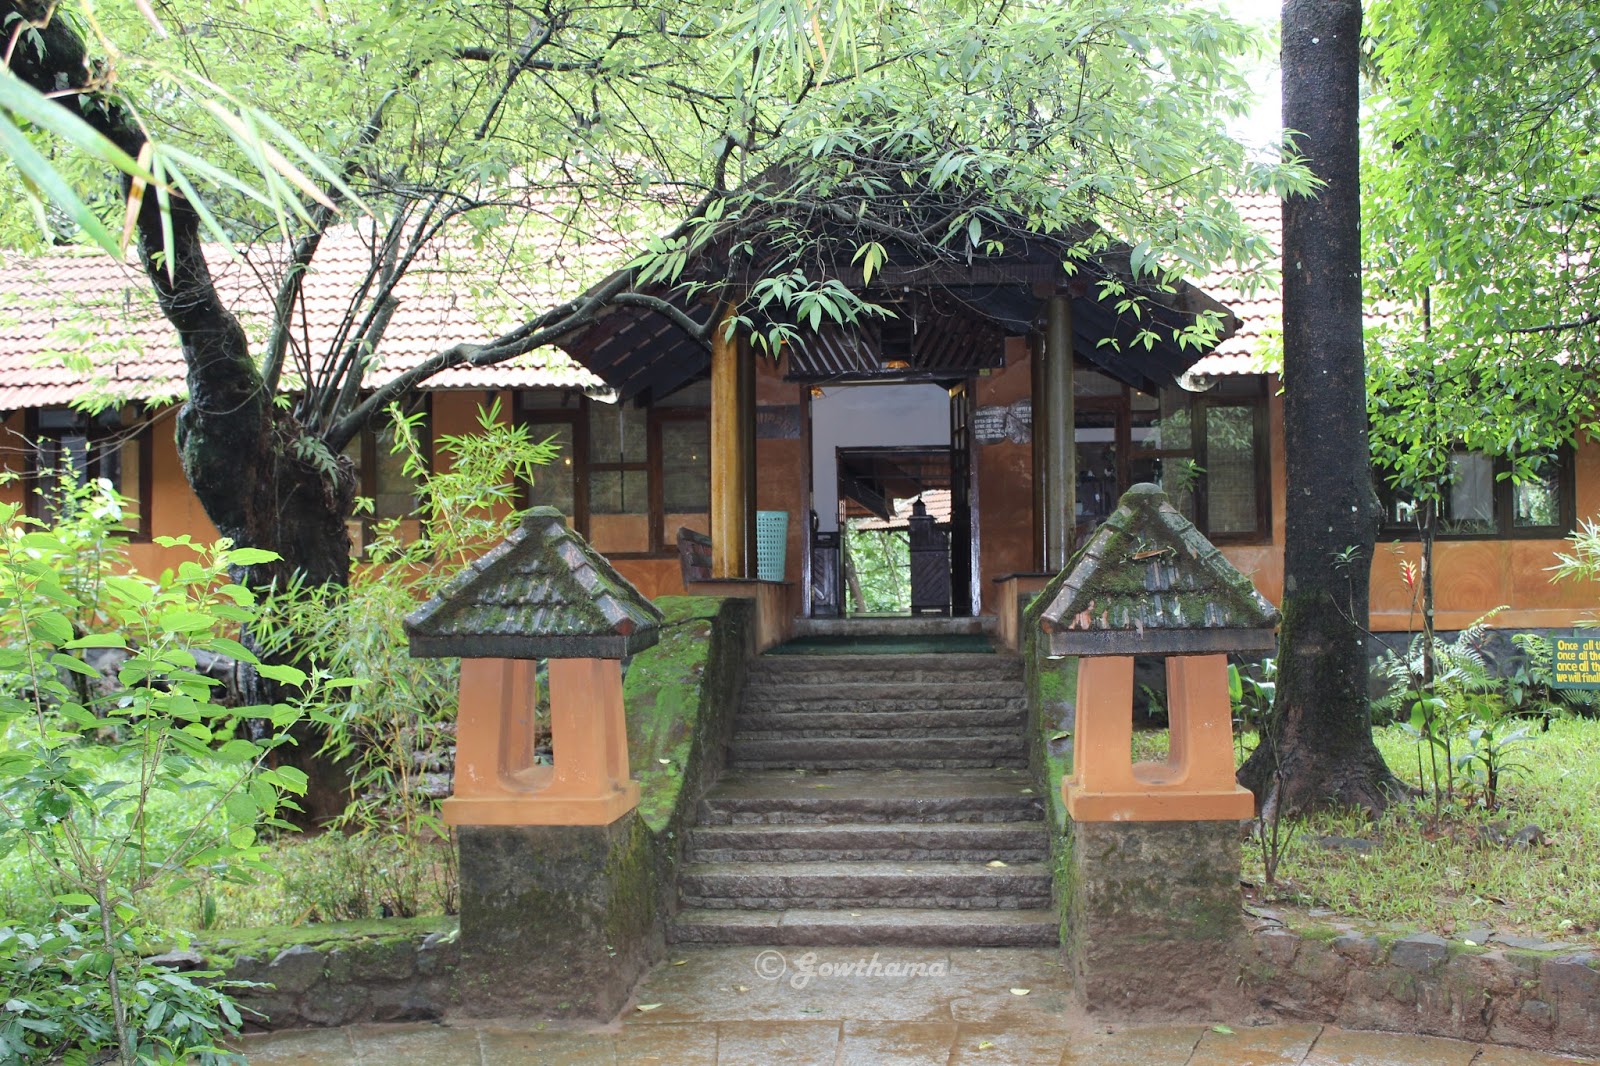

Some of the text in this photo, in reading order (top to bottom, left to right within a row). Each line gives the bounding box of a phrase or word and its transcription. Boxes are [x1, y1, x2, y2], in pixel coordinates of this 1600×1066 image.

[1557, 640, 1578, 651] Once
[1582, 640, 1594, 650] all
[1578, 651, 1588, 660] all
[1579, 661, 1589, 671] all
[1556, 673, 1568, 682] we
[1568, 672, 1581, 682] will
